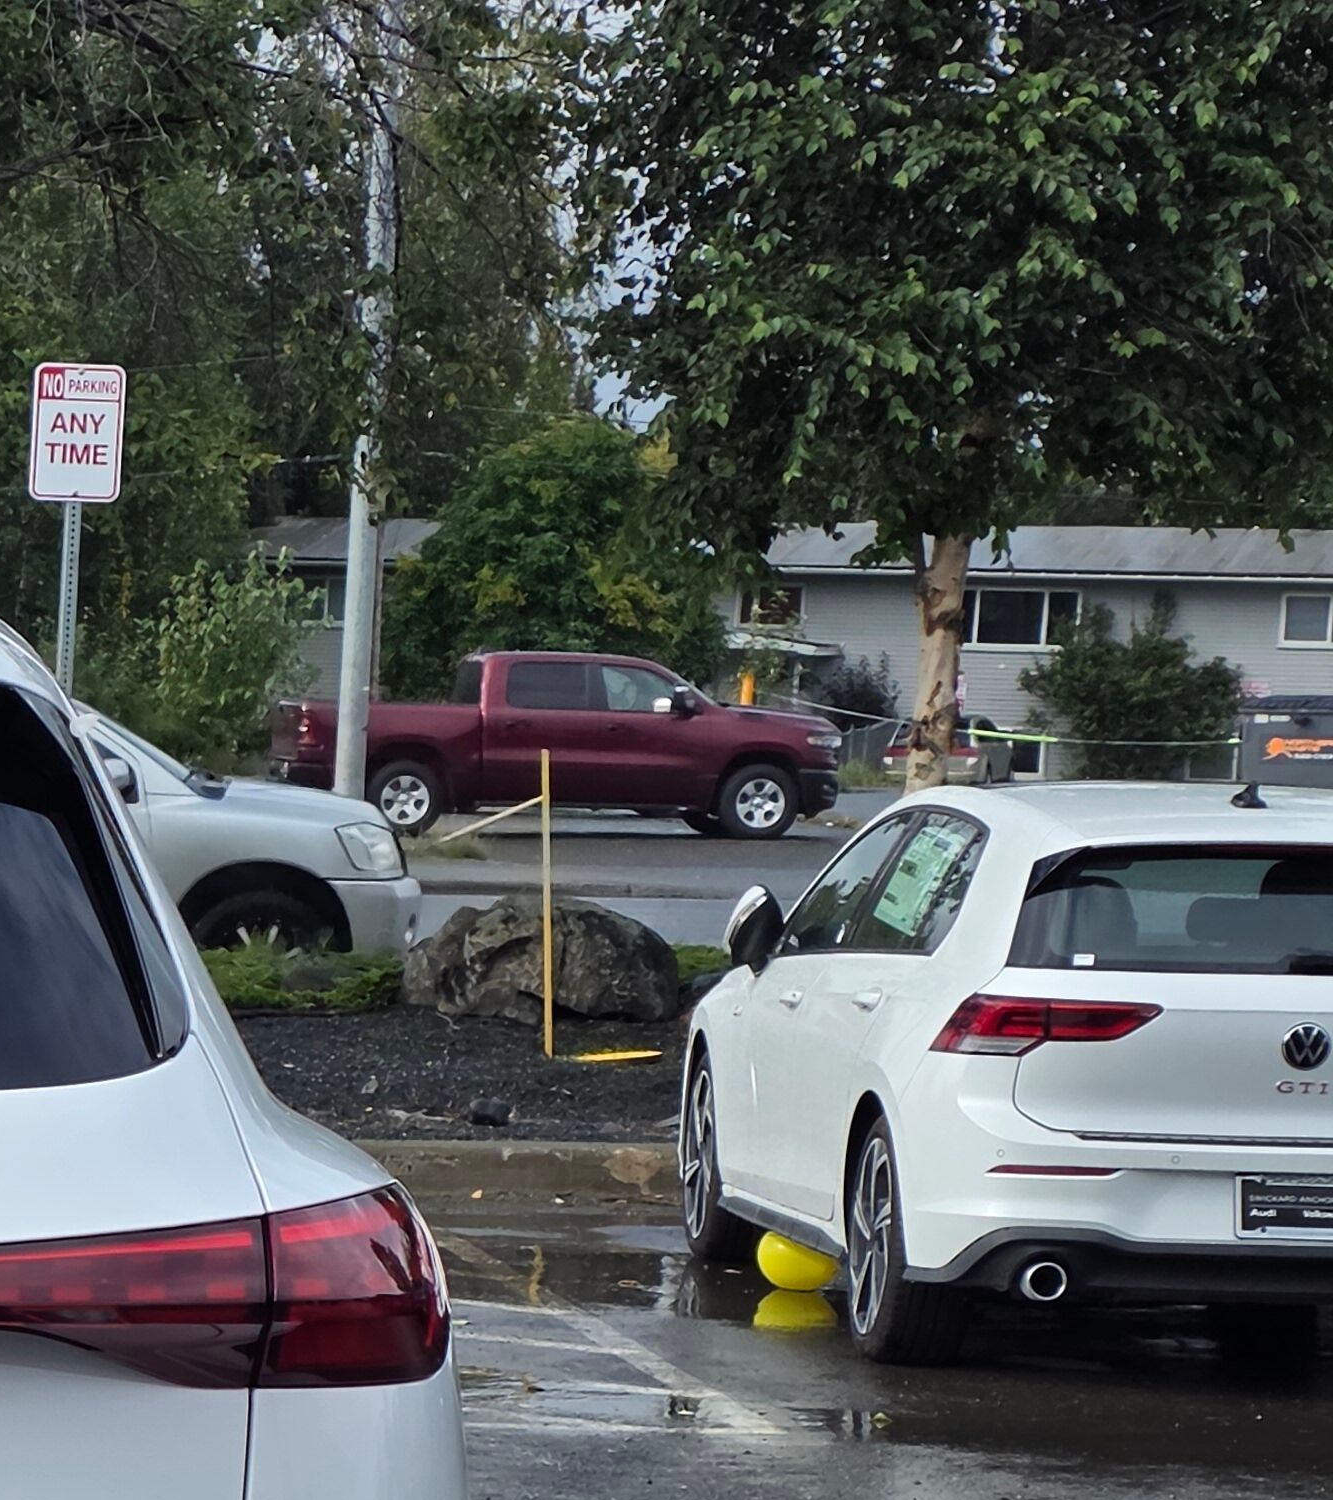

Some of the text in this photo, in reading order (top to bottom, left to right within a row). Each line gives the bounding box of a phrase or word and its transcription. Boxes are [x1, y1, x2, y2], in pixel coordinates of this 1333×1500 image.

[42, 373, 117, 398] NO PARKING
[50, 412, 106, 434] ANY
[45, 442, 109, 465] TIME
[1276, 1080, 1330, 1095] GTI
